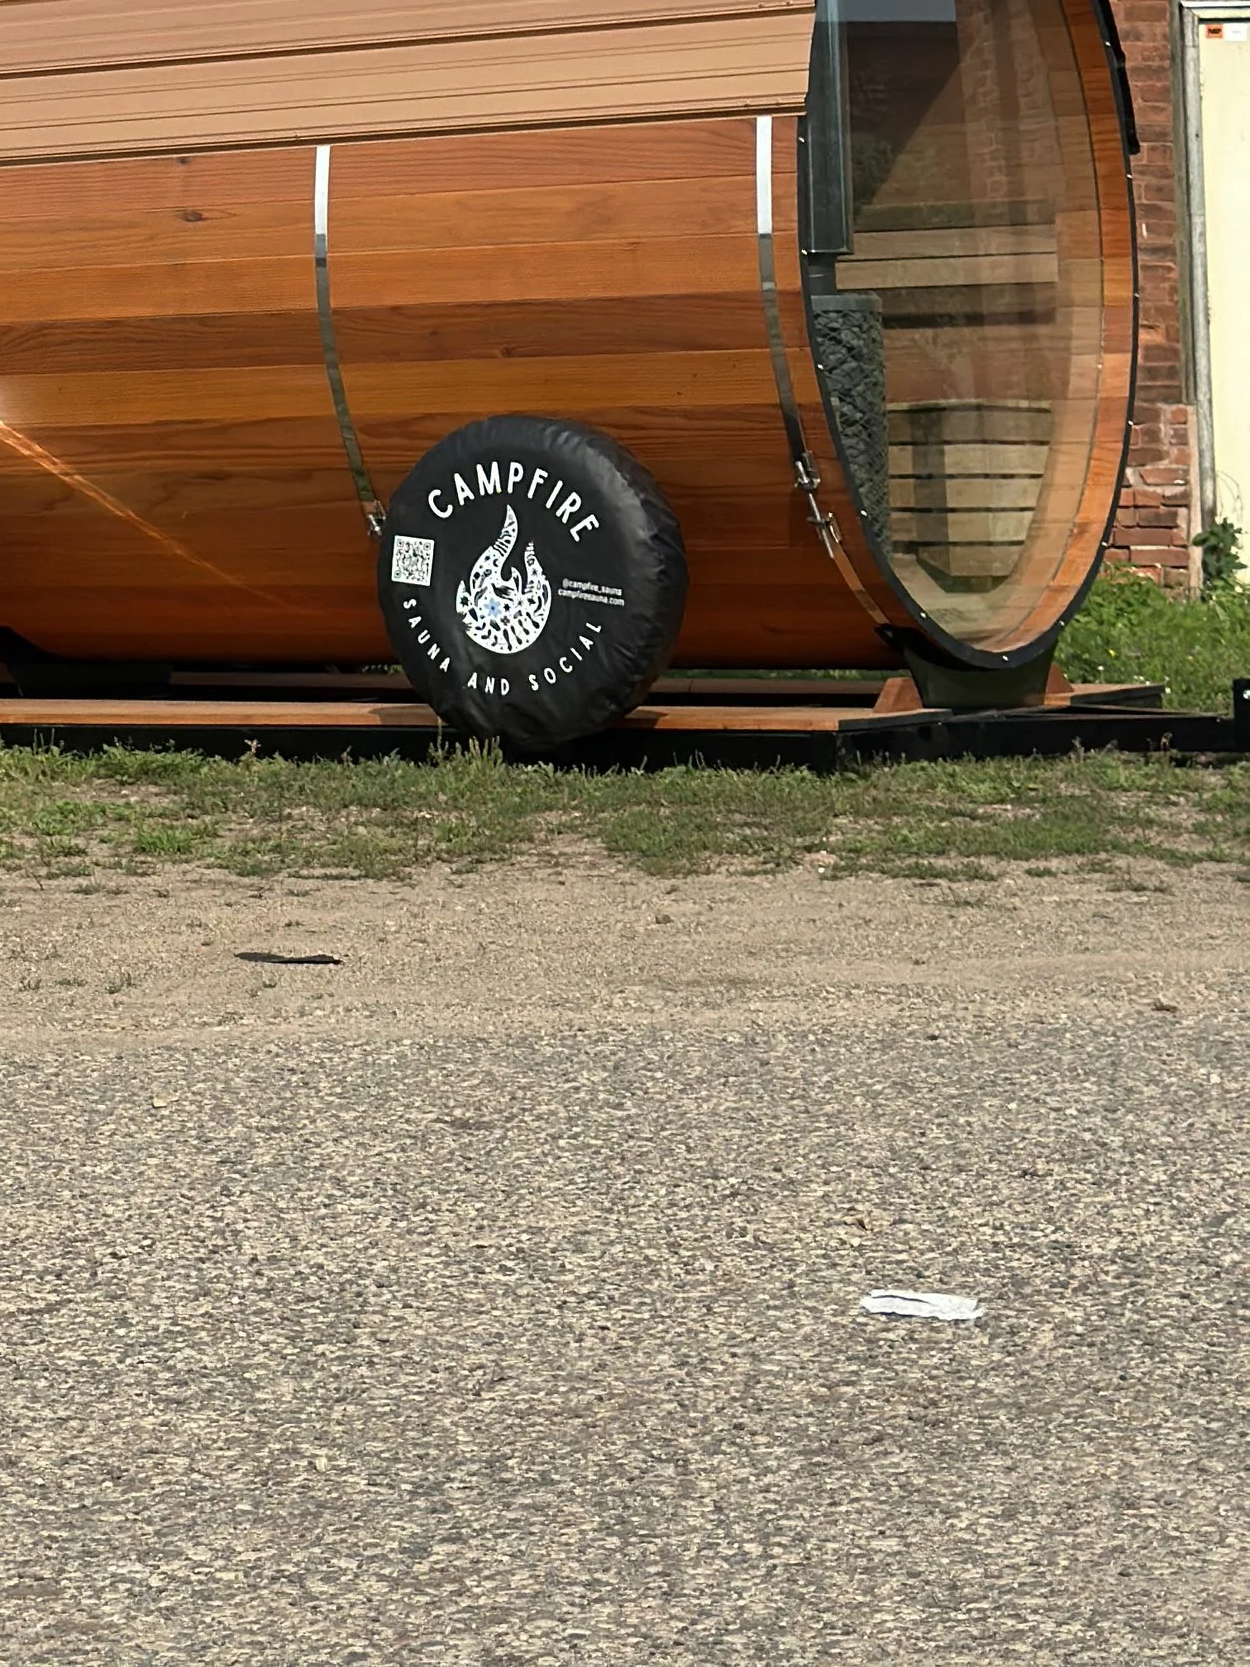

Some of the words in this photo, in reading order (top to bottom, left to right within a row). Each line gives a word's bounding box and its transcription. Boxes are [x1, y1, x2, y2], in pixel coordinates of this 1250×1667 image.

[427, 461, 600, 542] CAMPFIRE
[403, 598, 451, 673] SAUNA
[467, 672, 510, 696] AND
[528, 622, 602, 691] SOCIAL
